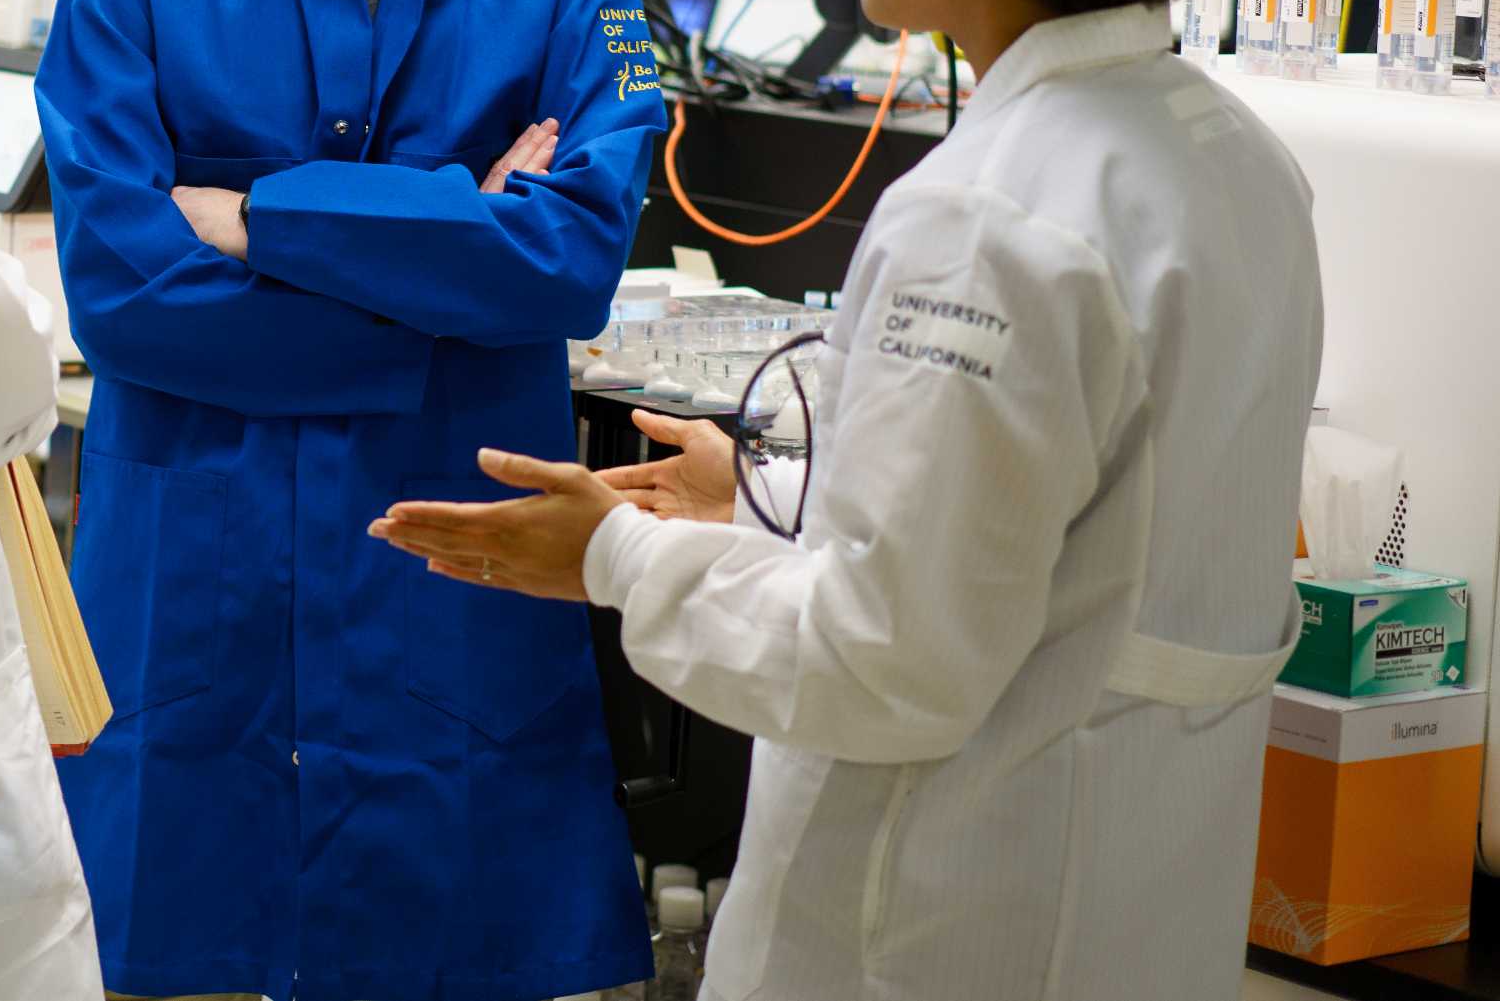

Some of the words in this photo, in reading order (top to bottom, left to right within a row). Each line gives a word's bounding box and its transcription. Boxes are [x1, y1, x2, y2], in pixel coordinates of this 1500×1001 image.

[603, 25, 624, 36] OF
[608, 40, 652, 53] CALIF
[634, 65, 652, 76] Be
[893, 292, 1010, 335] UNIVERSITY
[886, 314, 913, 331] OF
[878, 337, 991, 379] CALIFORNIA
[1376, 626, 1445, 649] KIMTECH
